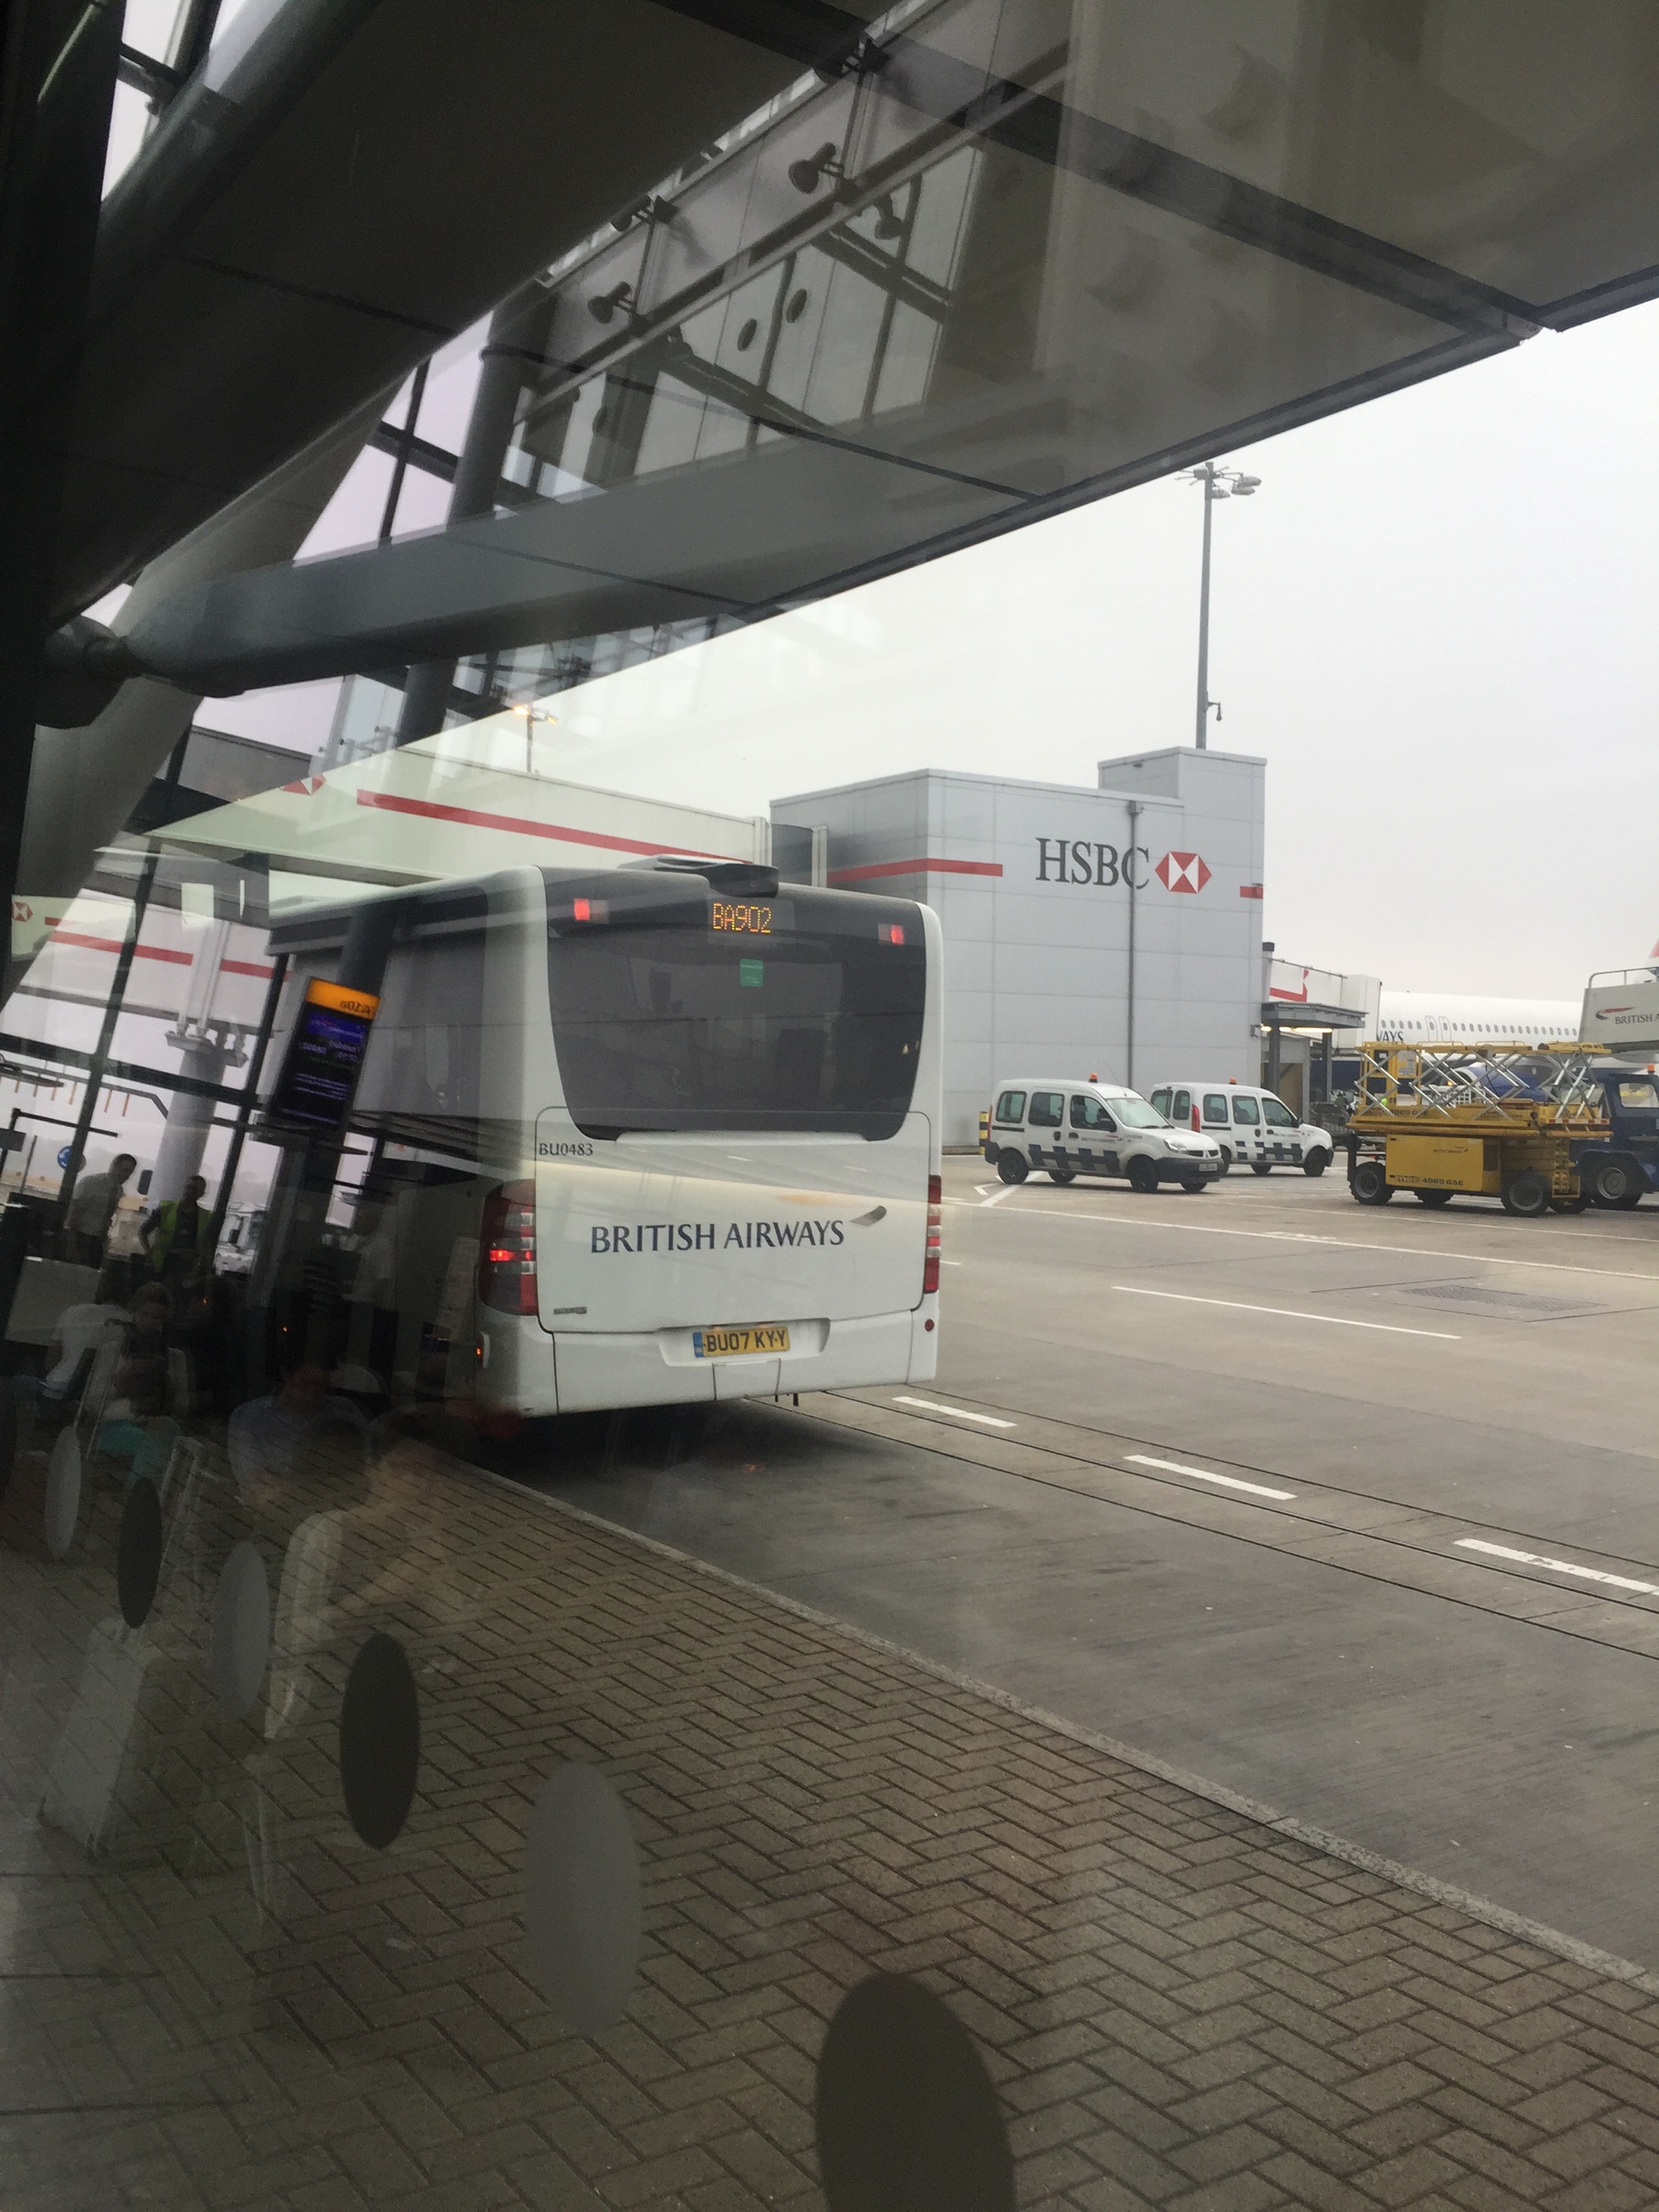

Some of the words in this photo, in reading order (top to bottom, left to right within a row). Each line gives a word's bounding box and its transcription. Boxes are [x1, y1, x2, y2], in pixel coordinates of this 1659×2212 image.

[1034, 837, 1149, 889] HSBC
[712, 902, 772, 934] BA902
[1615, 1013, 1653, 1025] BRITISH
[539, 1143, 593, 1156] BU0483
[590, 1223, 715, 1253] BRITISH
[723, 1220, 844, 1249] AIRWAYS
[706, 1332, 750, 1352] BU07
[754, 1329, 786, 1349] KYY
